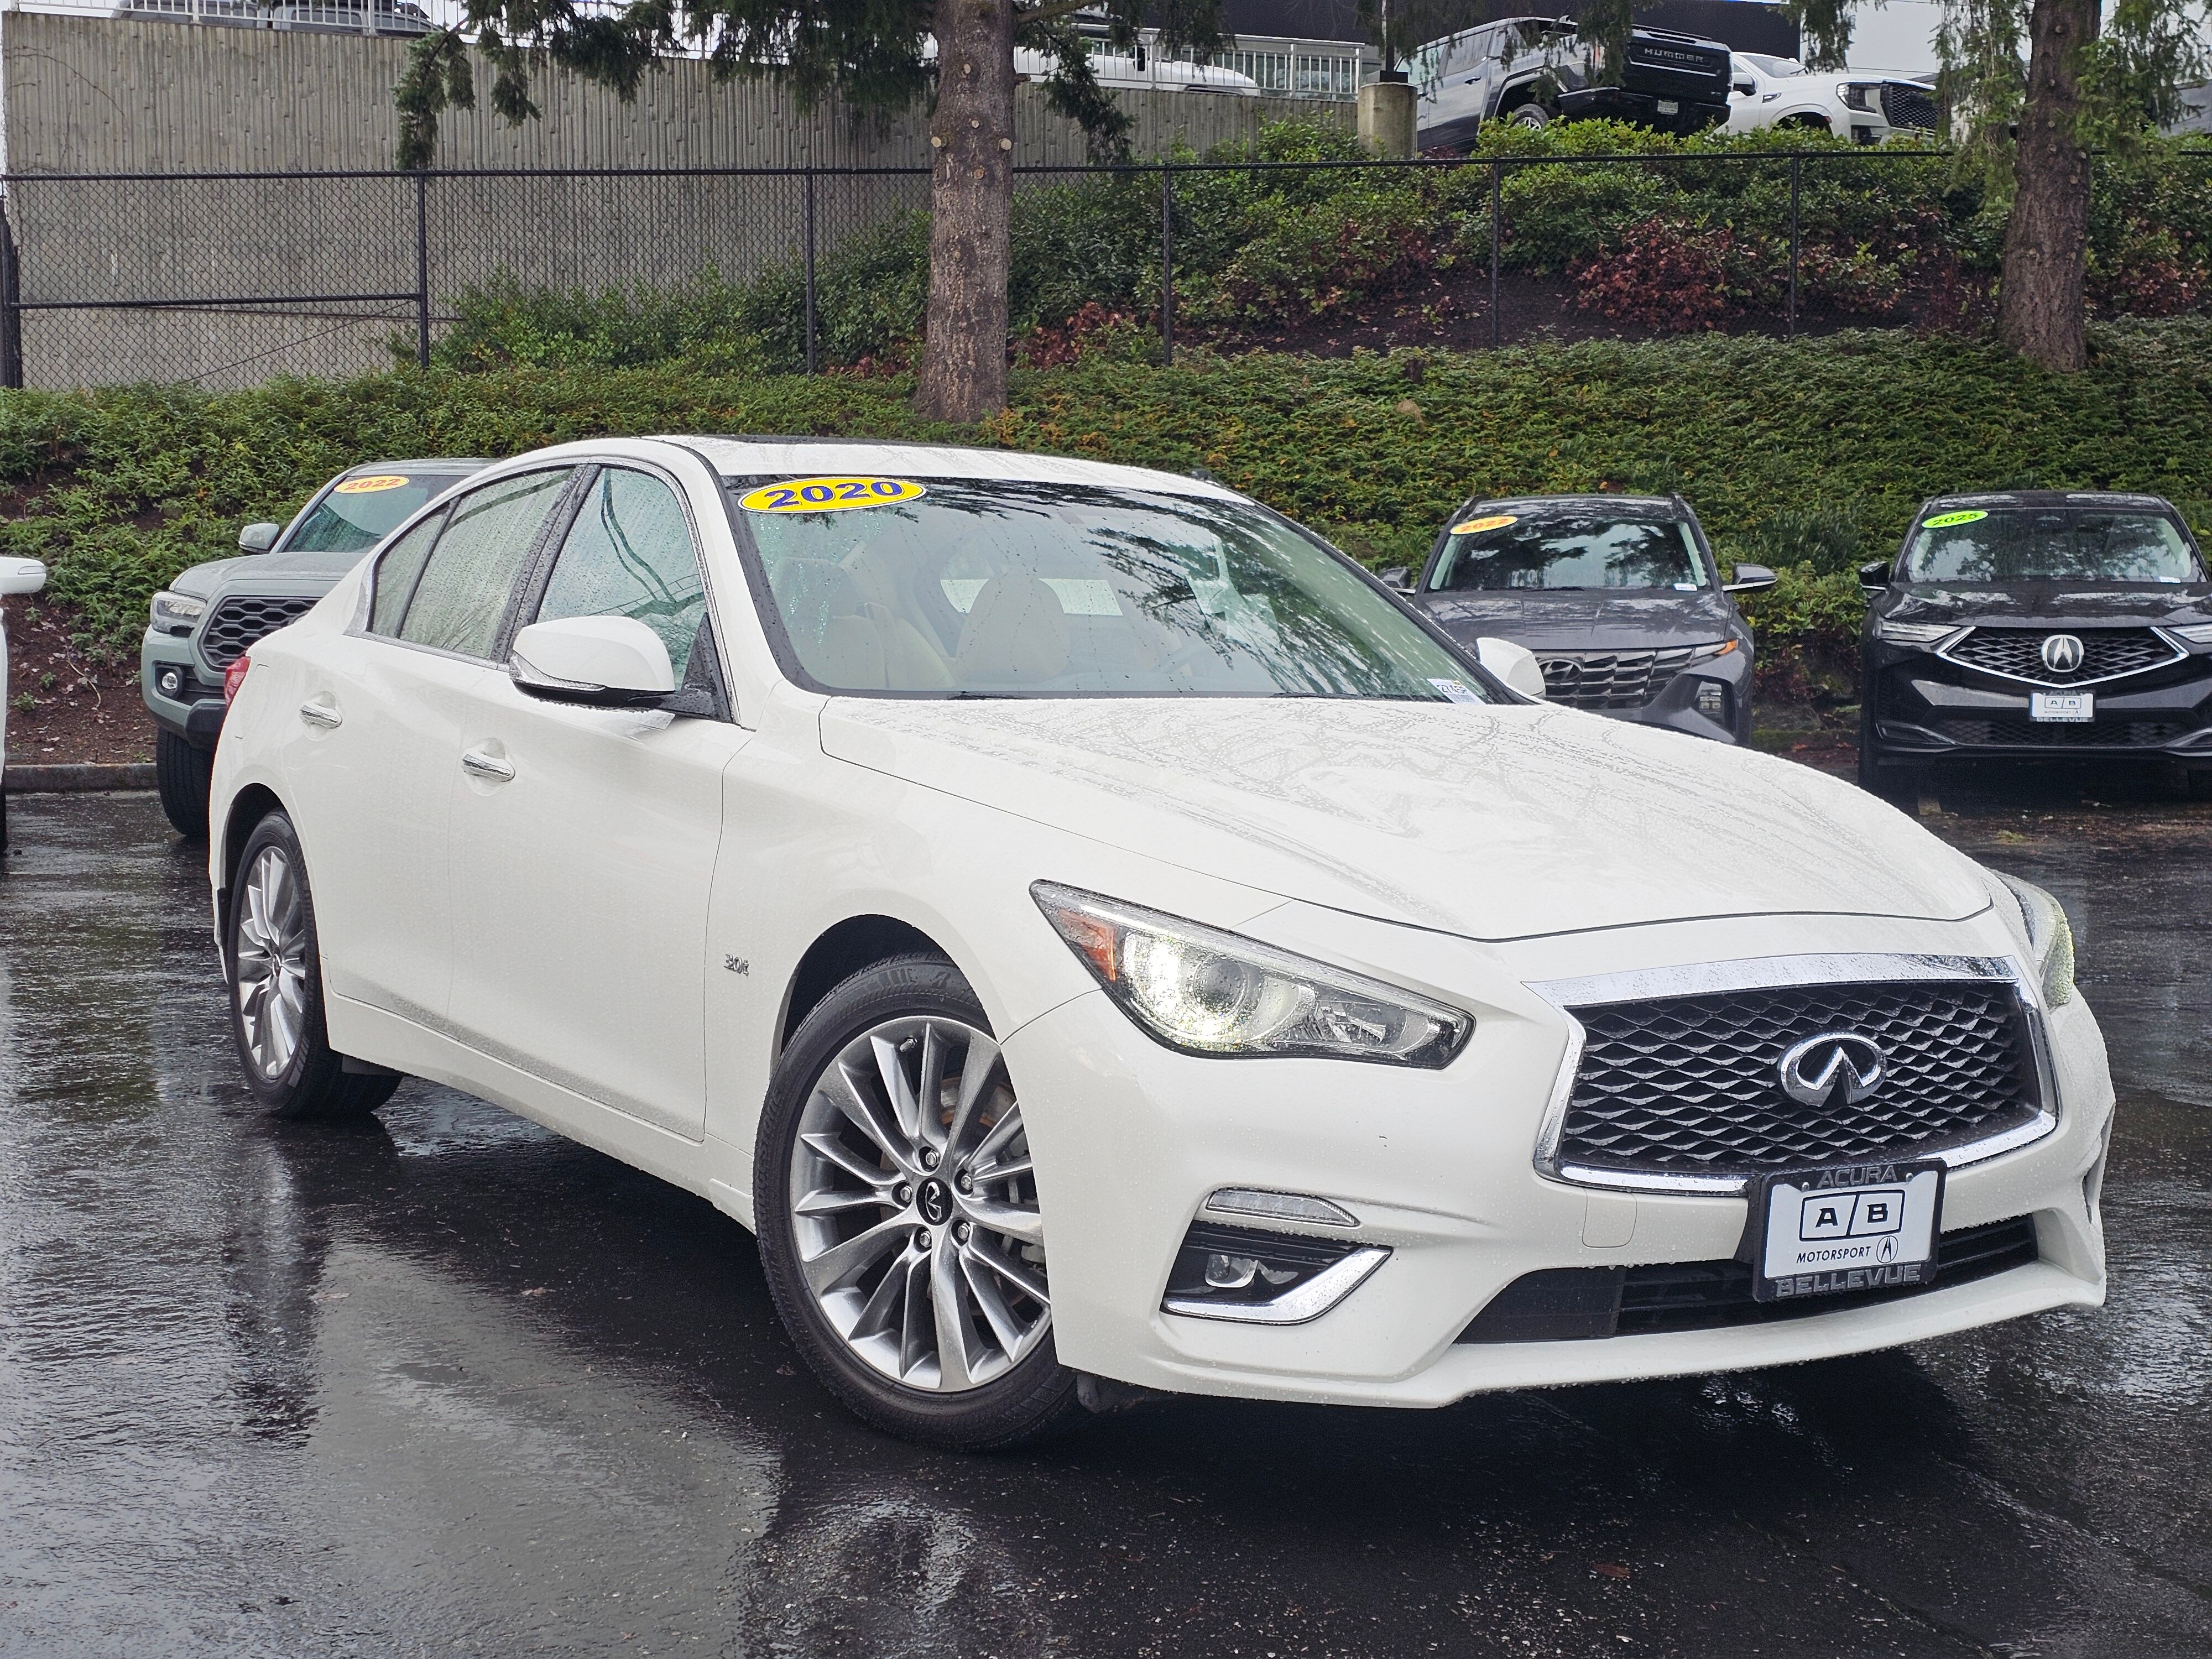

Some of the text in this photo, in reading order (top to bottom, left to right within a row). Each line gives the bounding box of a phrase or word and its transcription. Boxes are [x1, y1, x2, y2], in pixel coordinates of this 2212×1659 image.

[1645, 48, 1704, 62] HUMMER
[343, 478, 401, 491] 2022
[764, 481, 905, 509] 2020
[1460, 518, 1510, 533] 2022
[1932, 512, 1979, 526] 2025
[1817, 1165, 1898, 1189] ACURA
[1815, 1203, 1888, 1228] A B
[1796, 1245, 1871, 1264] MOTORSPORT
[1775, 1264, 1922, 1298] BELLEVUE
